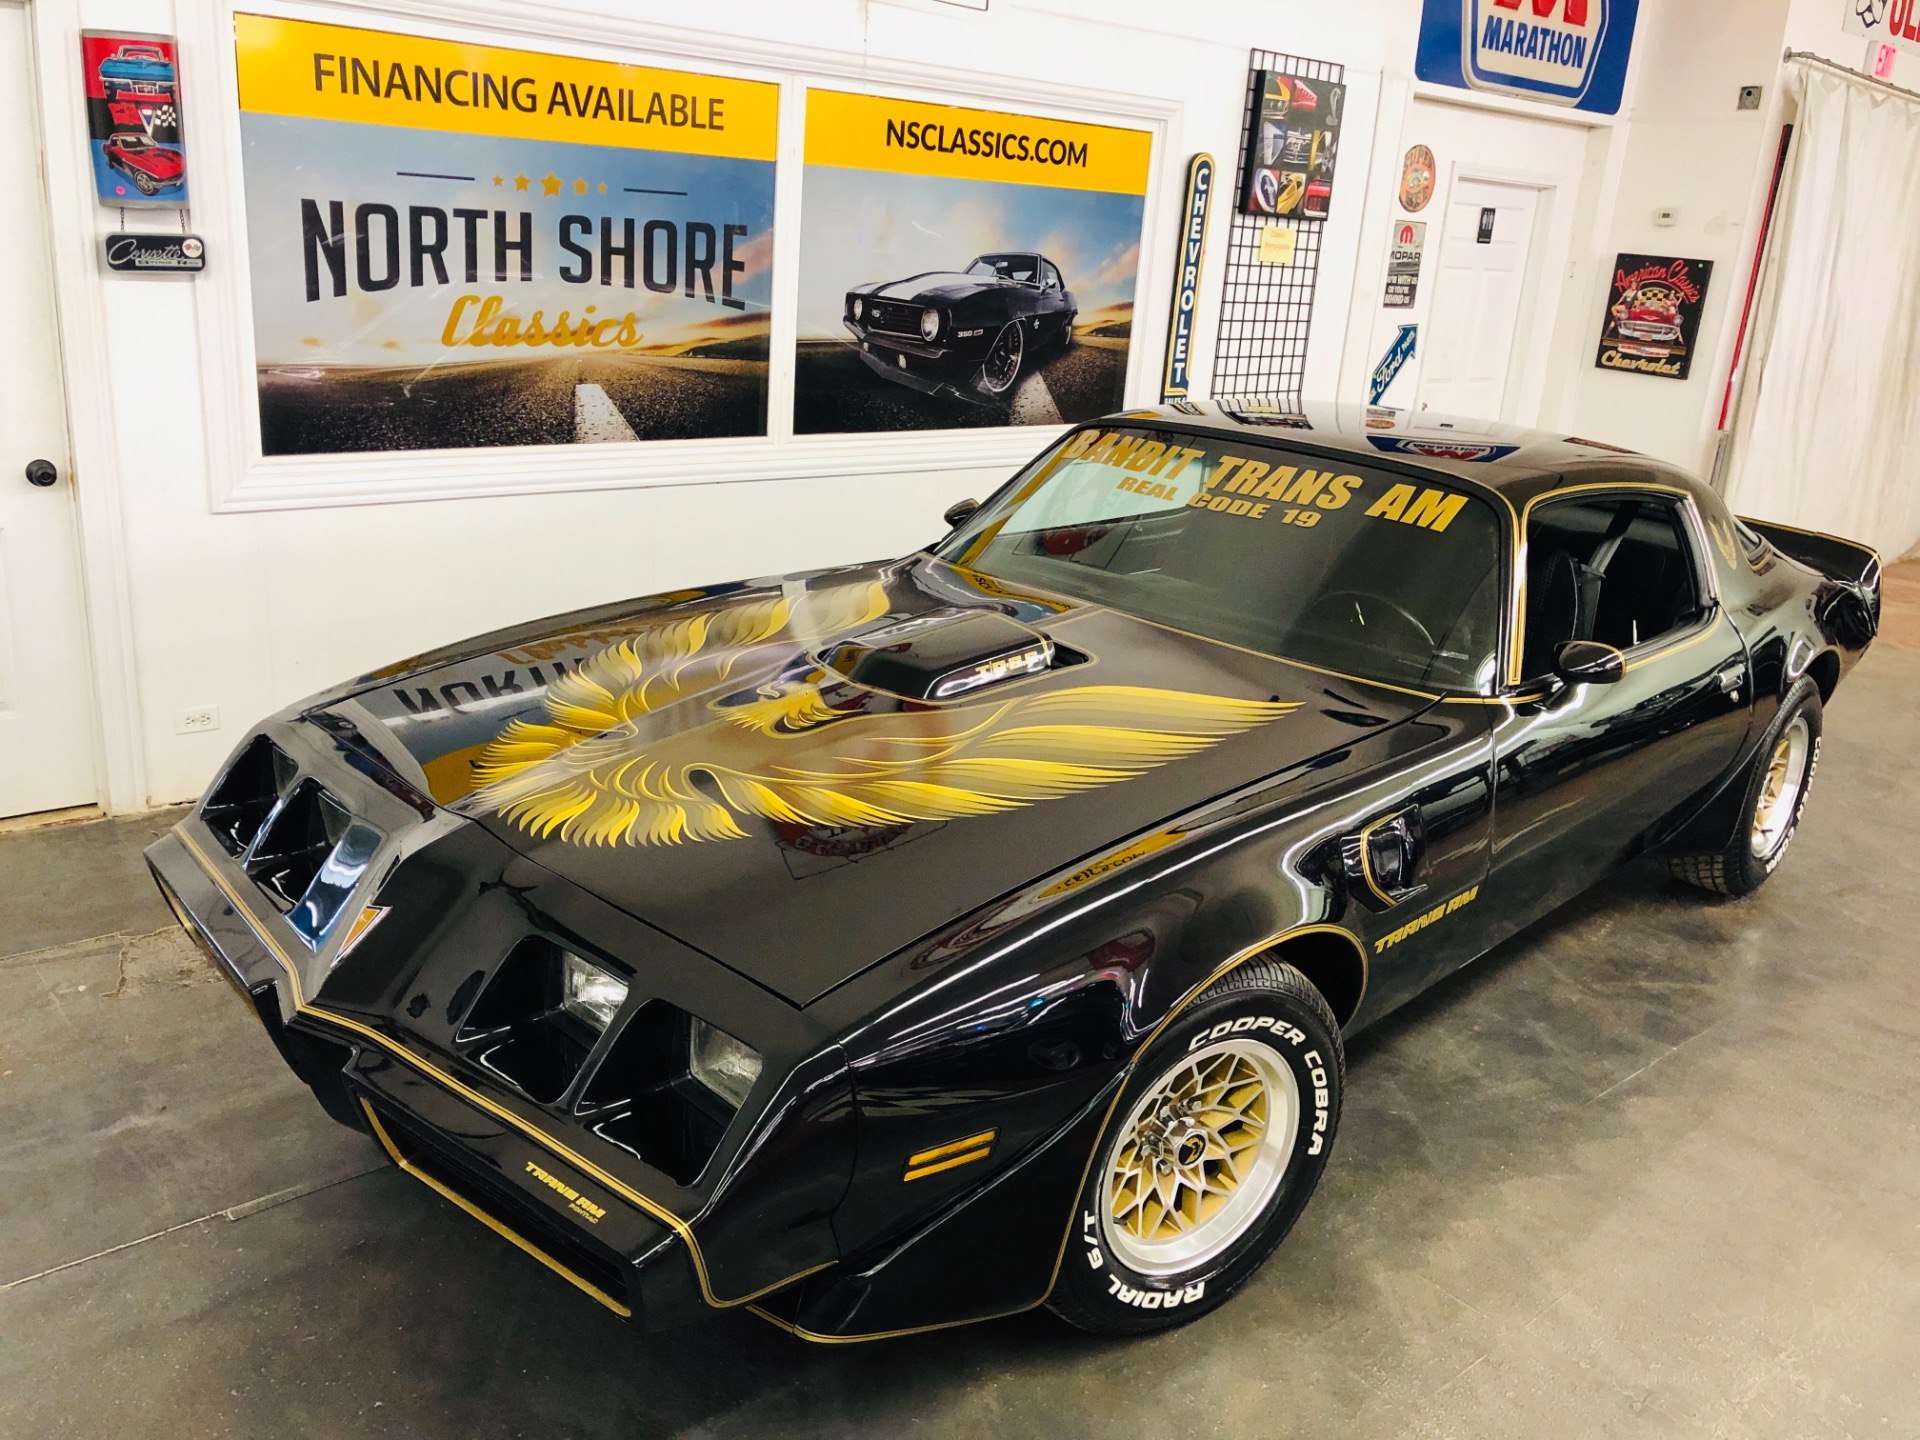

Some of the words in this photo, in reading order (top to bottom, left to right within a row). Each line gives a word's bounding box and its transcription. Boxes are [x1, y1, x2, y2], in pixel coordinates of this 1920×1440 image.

[1482, 15, 1587, 69] MARATHON
[313, 53, 537, 113] FINANCING
[547, 81, 725, 131] AVAILABLE
[886, 119, 1088, 168] NSCLASSICS.COM
[108, 239, 185, 264] Corvette
[300, 198, 533, 303] NORTH
[558, 214, 748, 310] SHORE
[1174, 168, 1210, 383] CHEVROLET
[441, 295, 644, 347] Classics
[1376, 347, 1404, 392] Ford
[1601, 350, 1682, 375] Chevrolet
[1062, 428, 1205, 487] BANDIT
[1205, 455, 1362, 510] TRANS
[1364, 483, 1469, 533] AM
[1116, 476, 1179, 501] REAL
[1188, 492, 1272, 520] CODE
[1281, 508, 1322, 528] 19
[1374, 903, 1447, 954] TRANS
[1446, 885, 1479, 914] AM
[1188, 1015, 1306, 1051] COOPER
[1304, 1050, 1329, 1155] COBRA
[525, 1161, 579, 1200] TRANS
[575, 1196, 606, 1218] AM
[1108, 1273, 1206, 1309] RADIAL
